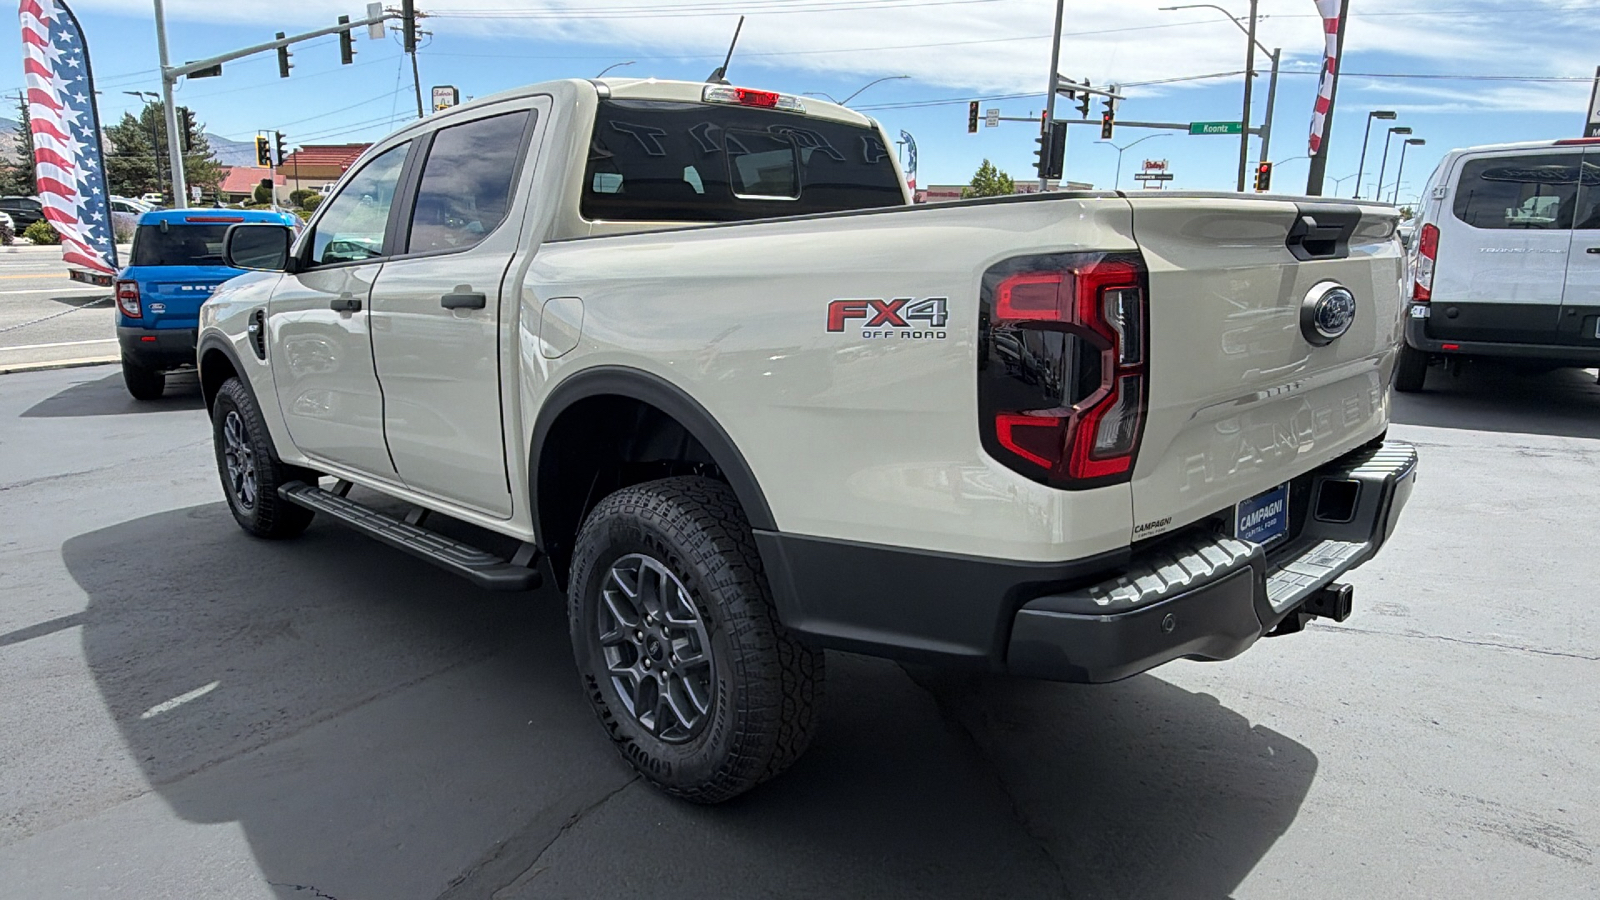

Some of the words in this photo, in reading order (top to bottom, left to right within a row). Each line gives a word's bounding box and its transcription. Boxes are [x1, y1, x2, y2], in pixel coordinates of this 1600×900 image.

[1203, 124, 1229, 133] Koontz
[825, 297, 948, 333] FX4
[862, 331, 894, 339] OFF
[900, 331, 947, 339] ROAD
[1180, 389, 1381, 492] RANGER
[1135, 516, 1172, 533] CAMPAGNI
[1240, 499, 1282, 531] CAMPAGNI
[1265, 518, 1277, 528] FORD
[585, 673, 673, 778] GOODYEAR
